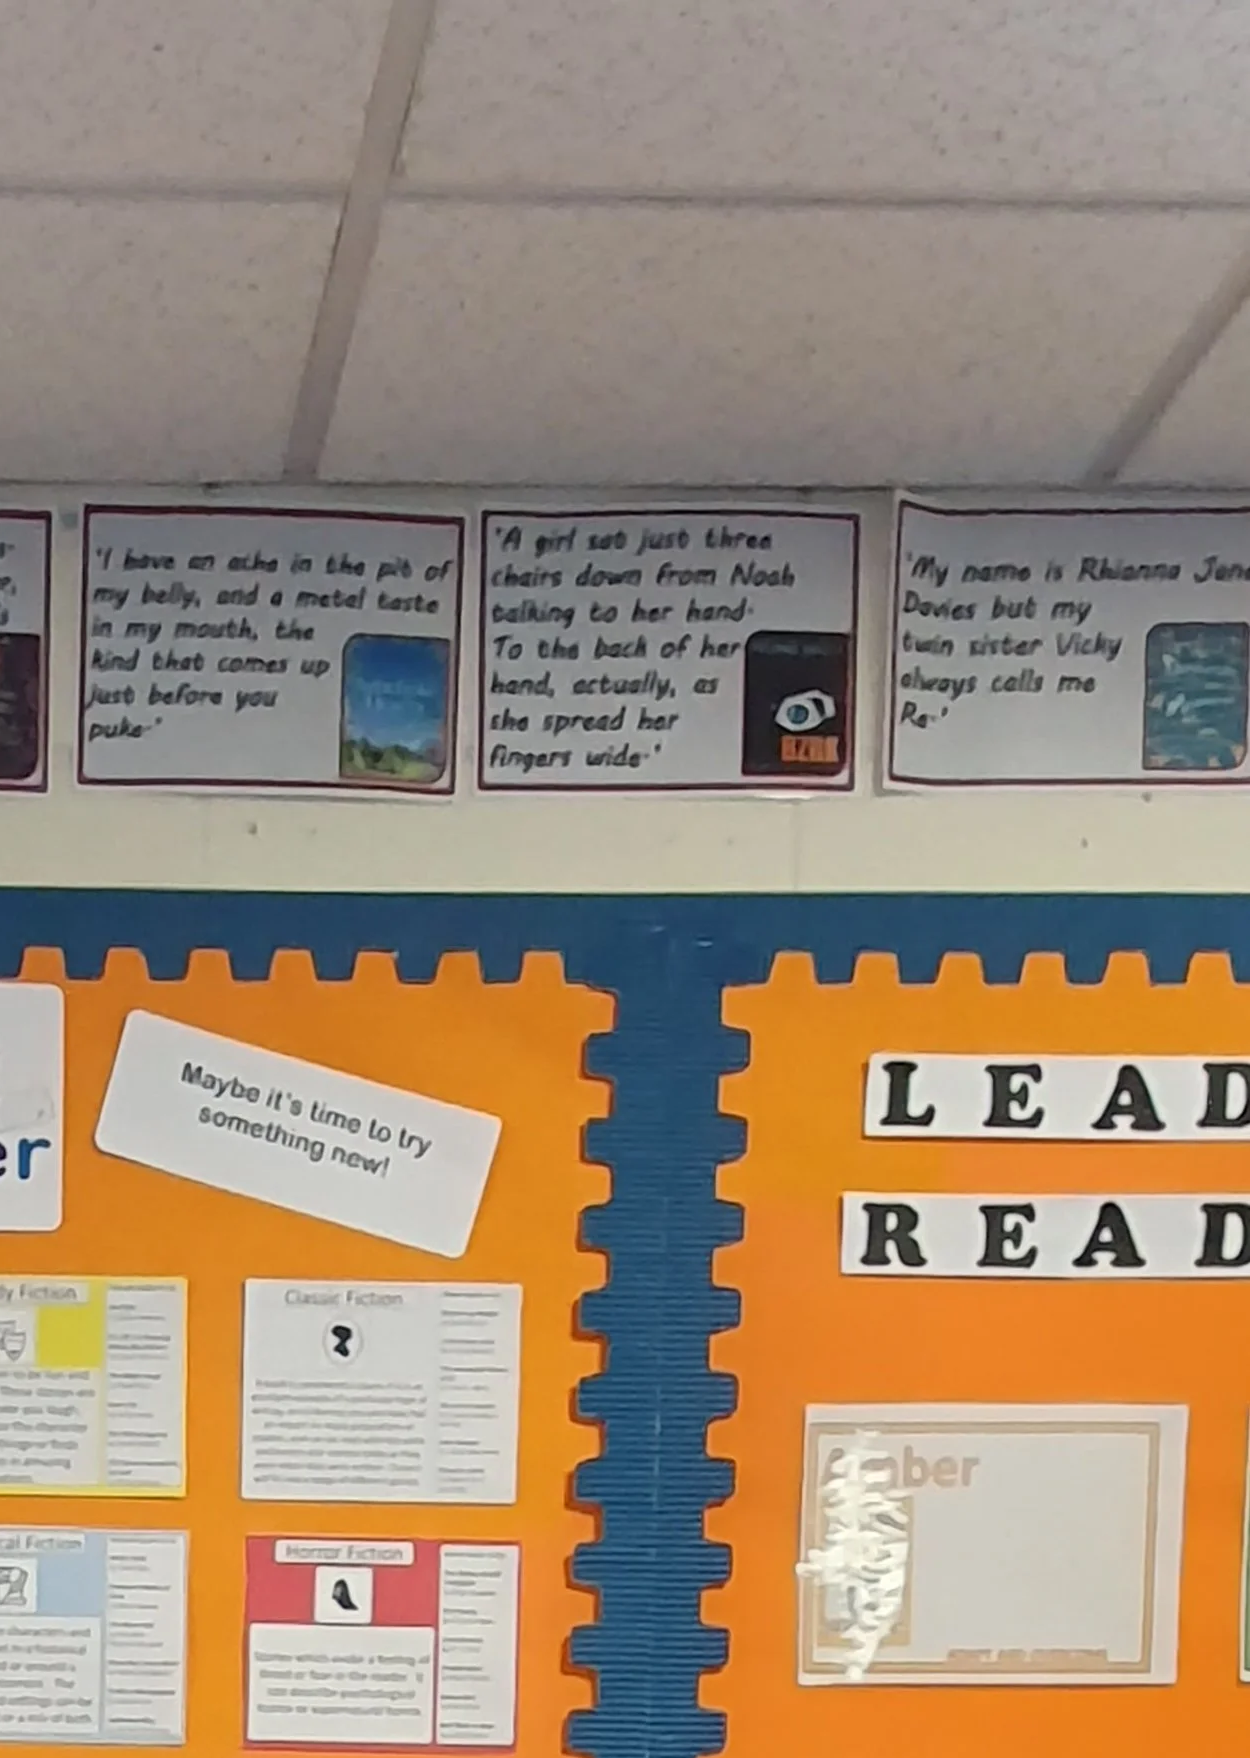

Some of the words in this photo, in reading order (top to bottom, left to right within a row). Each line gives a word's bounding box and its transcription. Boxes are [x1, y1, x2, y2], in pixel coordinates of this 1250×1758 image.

[534, 527, 577, 559] girl
[635, 528, 689, 556] just
[705, 526, 772, 550] three
[490, 564, 562, 587] chairs
[575, 562, 642, 587] down
[656, 562, 716, 586] from
[730, 561, 795, 587] Noah
[961, 564, 1031, 583] name
[1045, 562, 1063, 582] is
[491, 600, 575, 629] talking
[590, 602, 618, 623] to
[631, 598, 673, 623] her
[991, 595, 1037, 620] but
[1051, 602, 1092, 626] my
[493, 635, 522, 660] To
[538, 637, 579, 660] the
[594, 635, 647, 660] back
[660, 634, 692, 659] of
[700, 634, 741, 658] her
[902, 630, 954, 656] twin
[969, 634, 1043, 656] sister
[1057, 632, 1123, 662] Vicky
[91, 648, 140, 672] kind
[152, 649, 204, 672] that
[218, 657, 288, 674] comes
[300, 659, 330, 679] up
[87, 684, 135, 710] just
[148, 682, 222, 705] before
[235, 691, 278, 712] you
[693, 678, 719, 694] as
[900, 666, 977, 699] always
[991, 669, 1044, 692] calls
[1057, 675, 1095, 693] me
[490, 708, 529, 732] she
[543, 706, 626, 736] spread
[637, 707, 679, 731] her
[490, 744, 572, 774] fingers
[181, 1062, 260, 1104] Maybe
[265, 1088, 303, 1117] it's
[310, 1101, 361, 1133] time
[368, 1119, 393, 1143] to
[398, 1128, 432, 1158] try
[198, 1106, 326, 1162] something
[330, 1145, 391, 1179] new!
